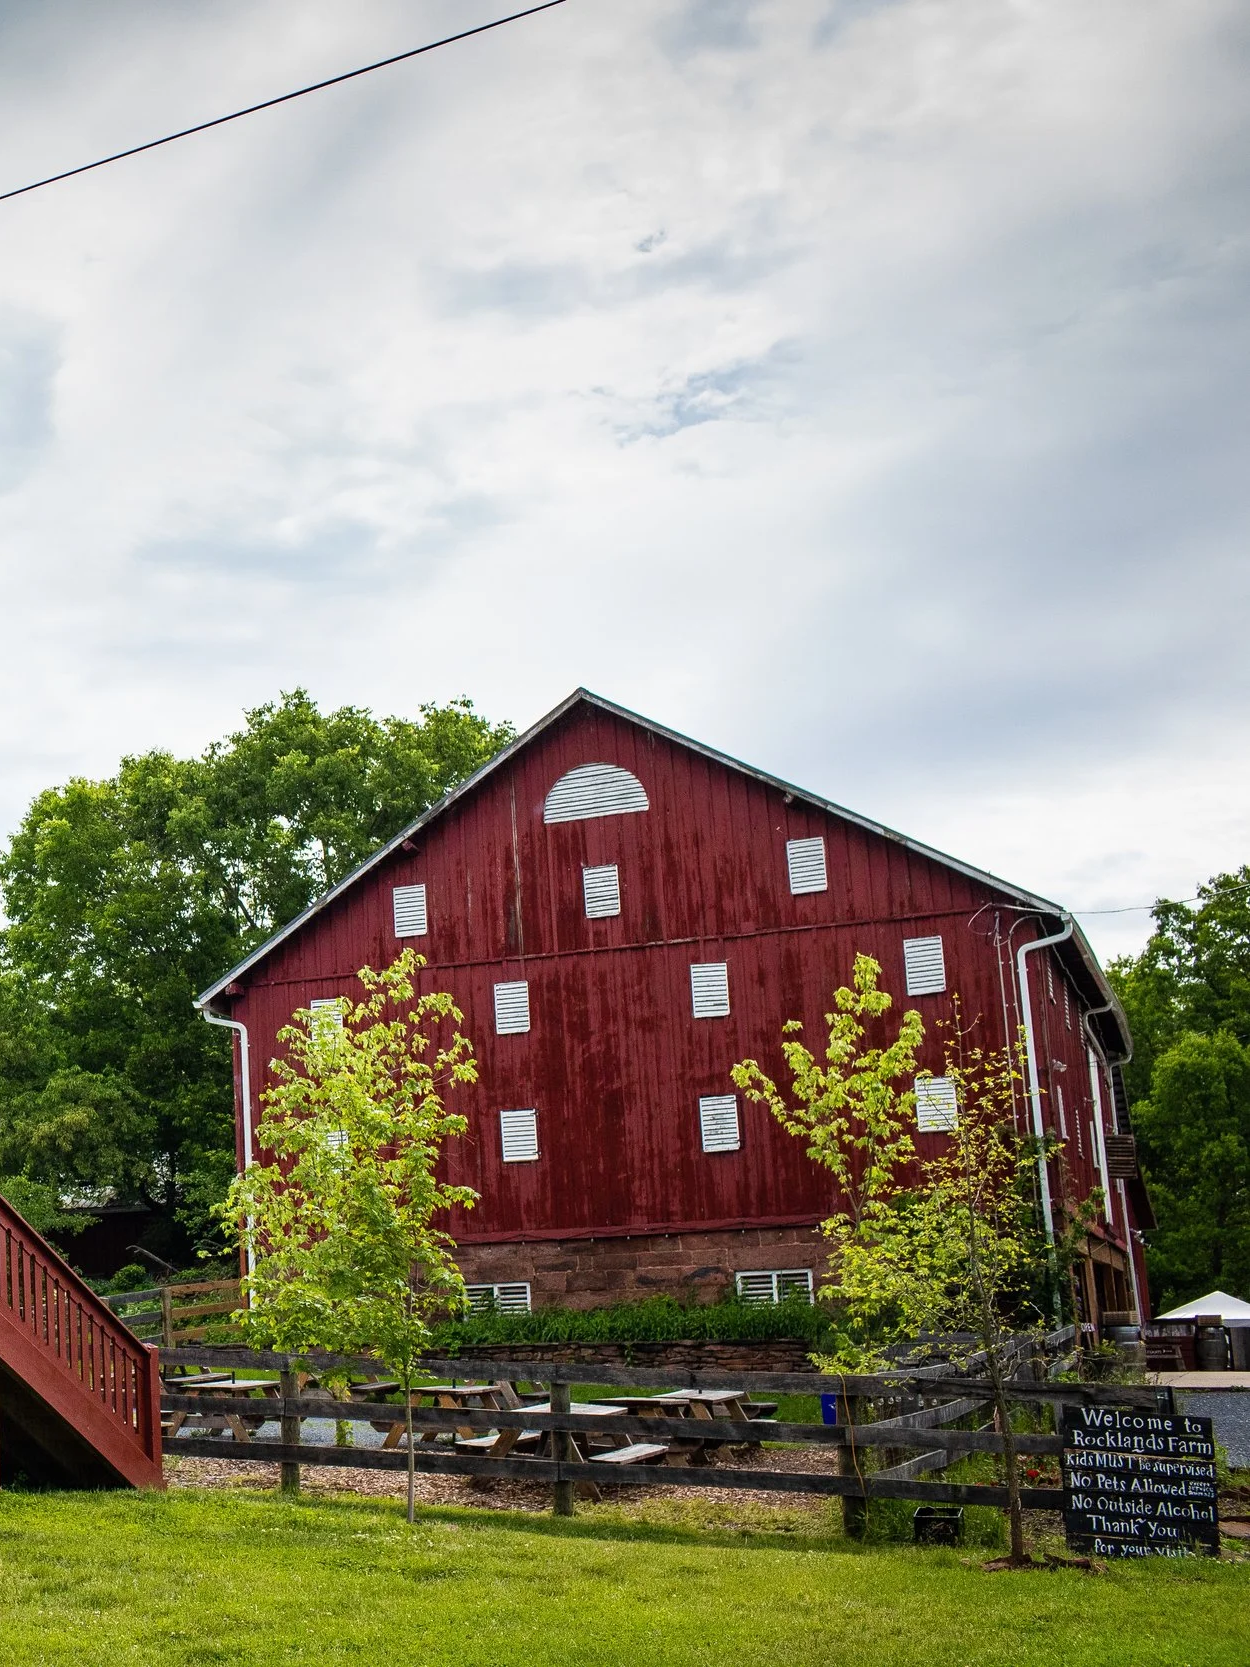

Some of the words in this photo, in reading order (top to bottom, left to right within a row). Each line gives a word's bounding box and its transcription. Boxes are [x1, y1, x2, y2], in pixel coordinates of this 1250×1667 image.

[1081, 1408, 1173, 1431] Welcome
[1184, 1418, 1202, 1433] to
[1072, 1430, 1164, 1451] Rocklands
[1168, 1437, 1213, 1455] Farm
[1095, 1453, 1134, 1470] MUST
[1139, 1457, 1151, 1471] be
[1152, 1461, 1214, 1478] supervised
[1070, 1472, 1091, 1489] No
[1096, 1473, 1126, 1491] Pets
[1131, 1478, 1188, 1497] Allowed
[1071, 1494, 1093, 1510] No
[1097, 1497, 1153, 1516] Outside
[1156, 1502, 1214, 1522] Alcohol
[1087, 1514, 1140, 1535] Thank
[1095, 1539, 1115, 1554] for
[1121, 1544, 1150, 1557] your
